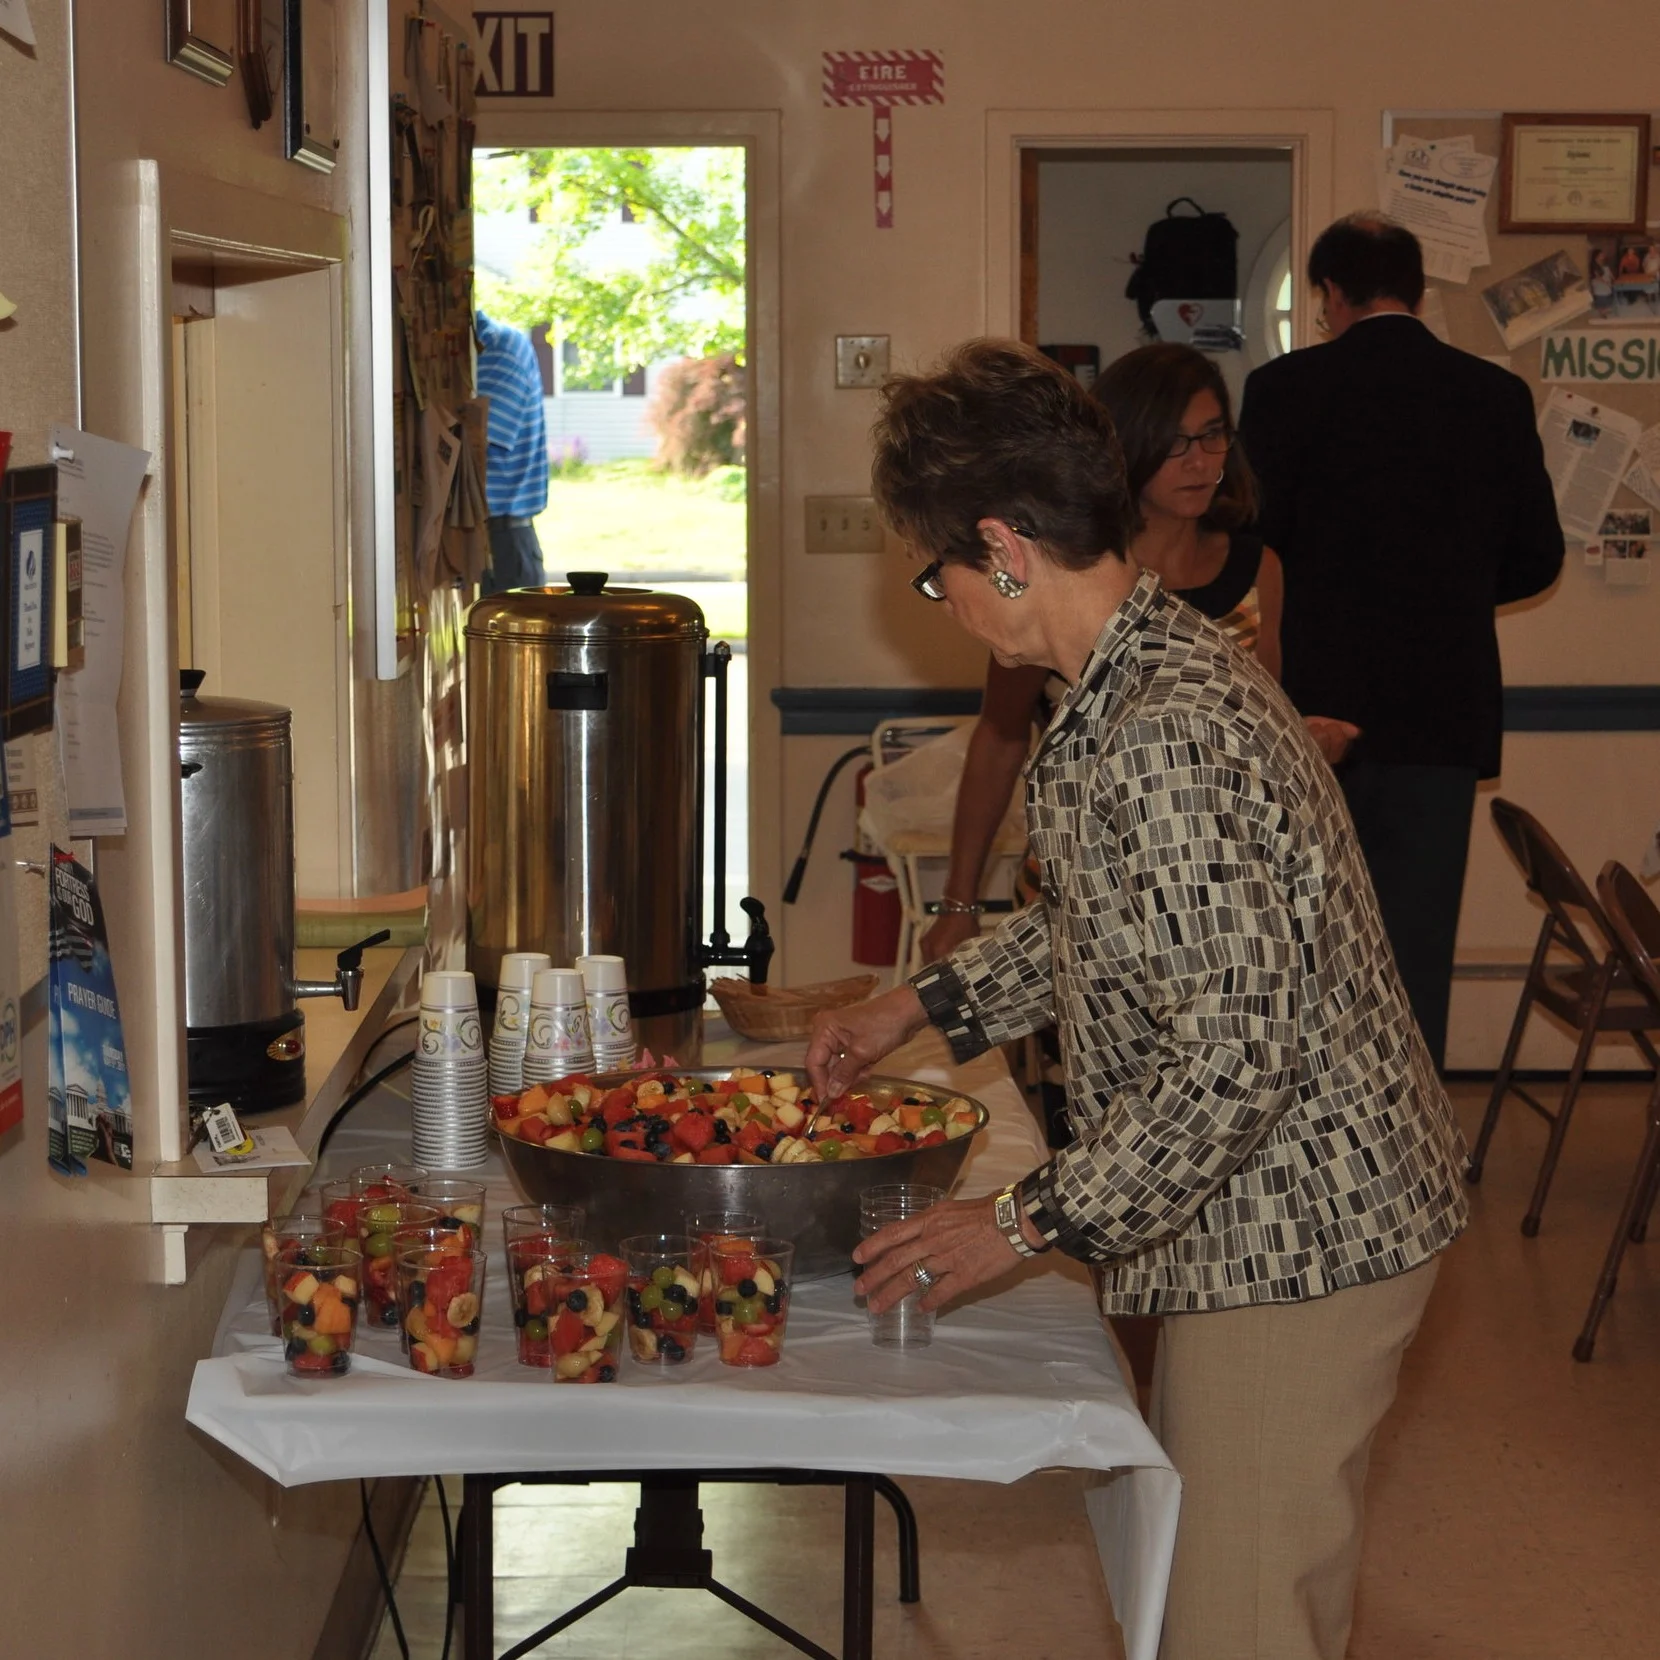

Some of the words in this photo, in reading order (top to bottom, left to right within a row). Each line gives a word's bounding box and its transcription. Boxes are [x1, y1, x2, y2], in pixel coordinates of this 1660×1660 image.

[472, 17, 550, 92] XIT
[859, 65, 907, 80] FIRE
[1542, 336, 1660, 380] MISSI
[55, 866, 90, 902] FORTRESS
[72, 894, 94, 926] GOD
[67, 982, 97, 1011] PRAYER
[96, 994, 117, 1019] GUIDE
